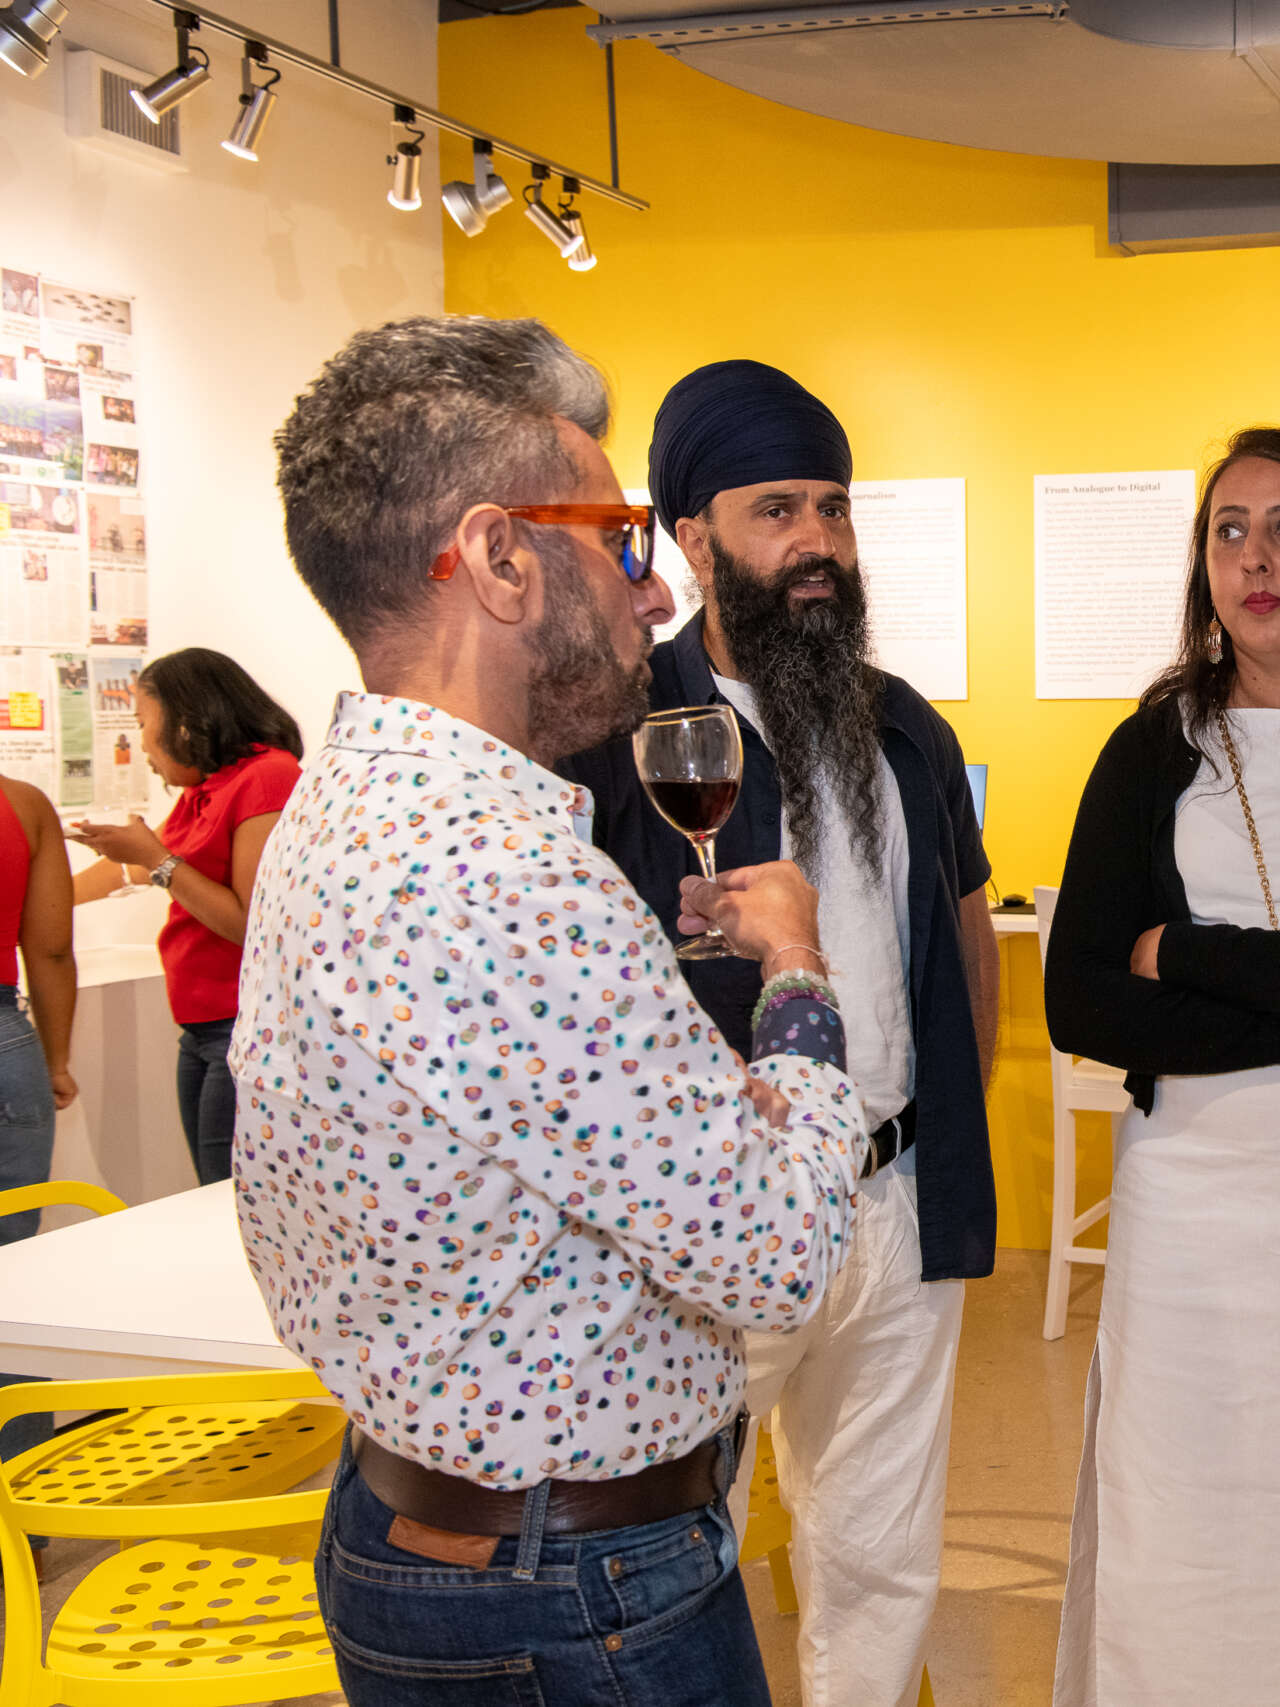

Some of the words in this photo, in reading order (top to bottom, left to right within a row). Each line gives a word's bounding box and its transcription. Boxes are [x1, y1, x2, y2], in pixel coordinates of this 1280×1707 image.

[1045, 486, 1070, 495] From
[1073, 484, 1115, 494] Analogue
[1118, 484, 1128, 492] to
[1129, 481, 1160, 493] Digital
